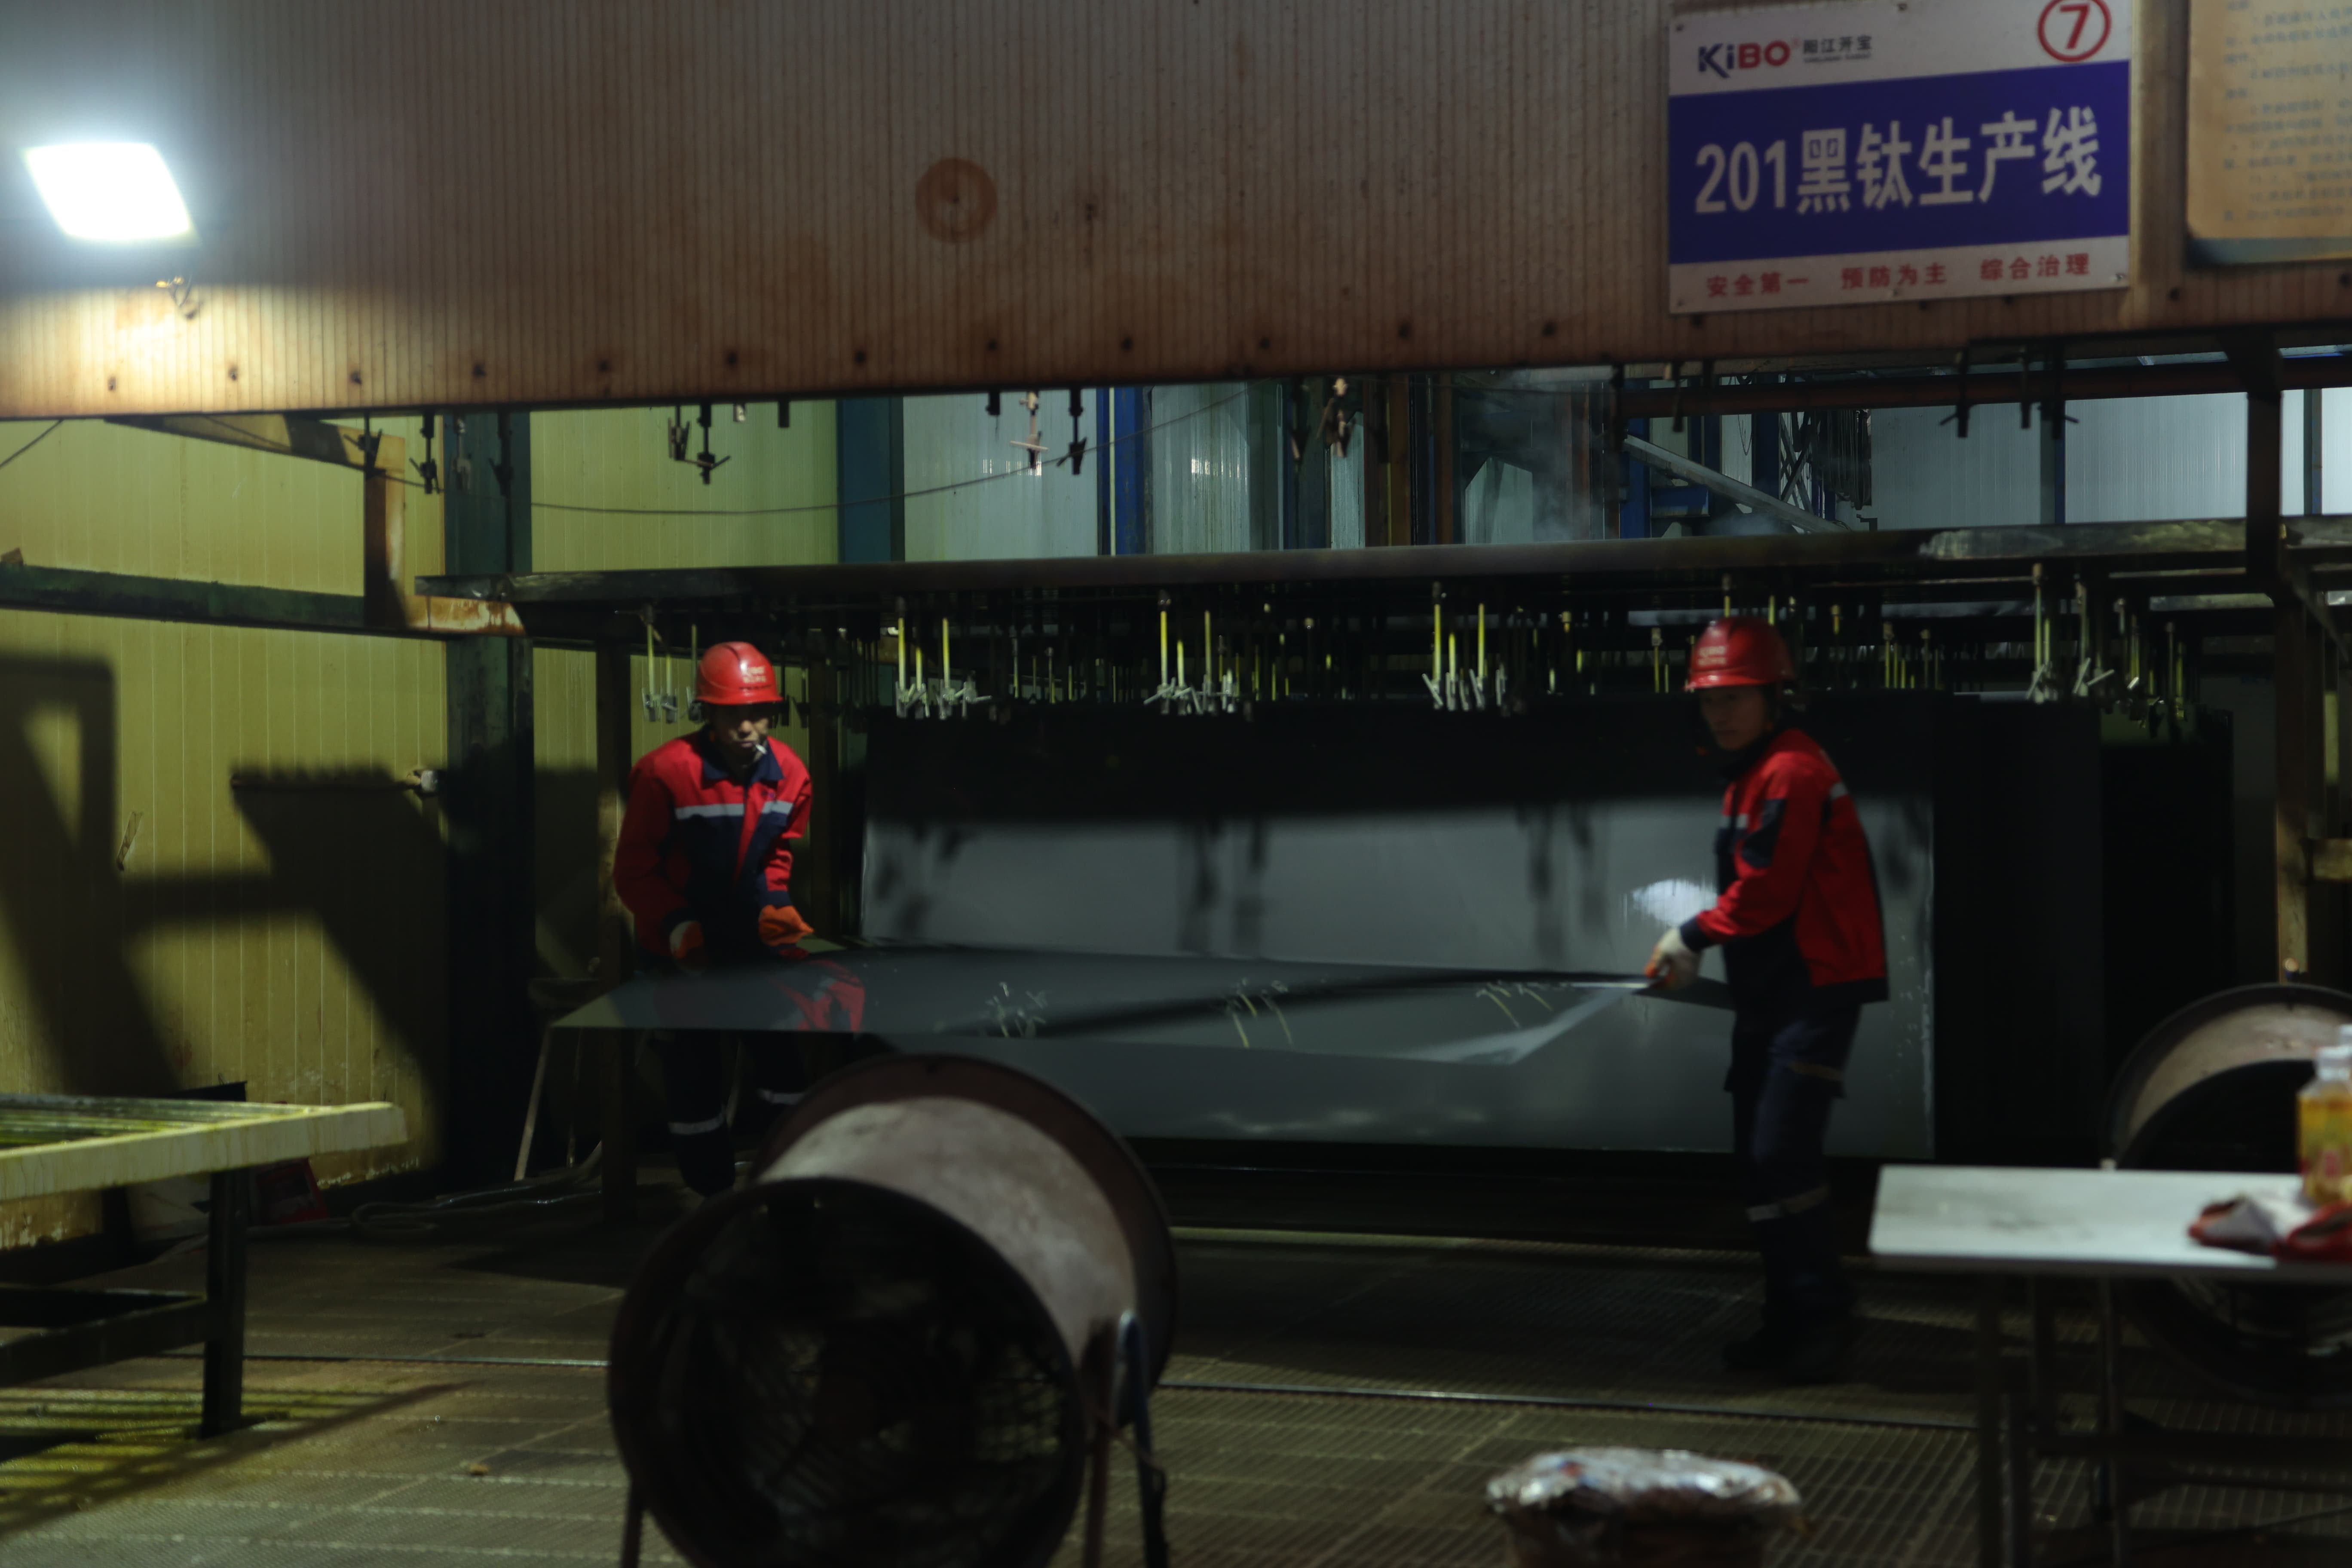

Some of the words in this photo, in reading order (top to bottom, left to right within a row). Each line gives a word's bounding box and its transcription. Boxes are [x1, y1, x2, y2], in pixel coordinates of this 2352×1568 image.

[2059, 3, 2092, 50] 7
[1695, 105, 2102, 215] 201黑钛生产线
[1706, 271, 1810, 298] 安全第一
[1841, 262, 1947, 291] 预防为主
[1980, 252, 2091, 282] 综合治理
